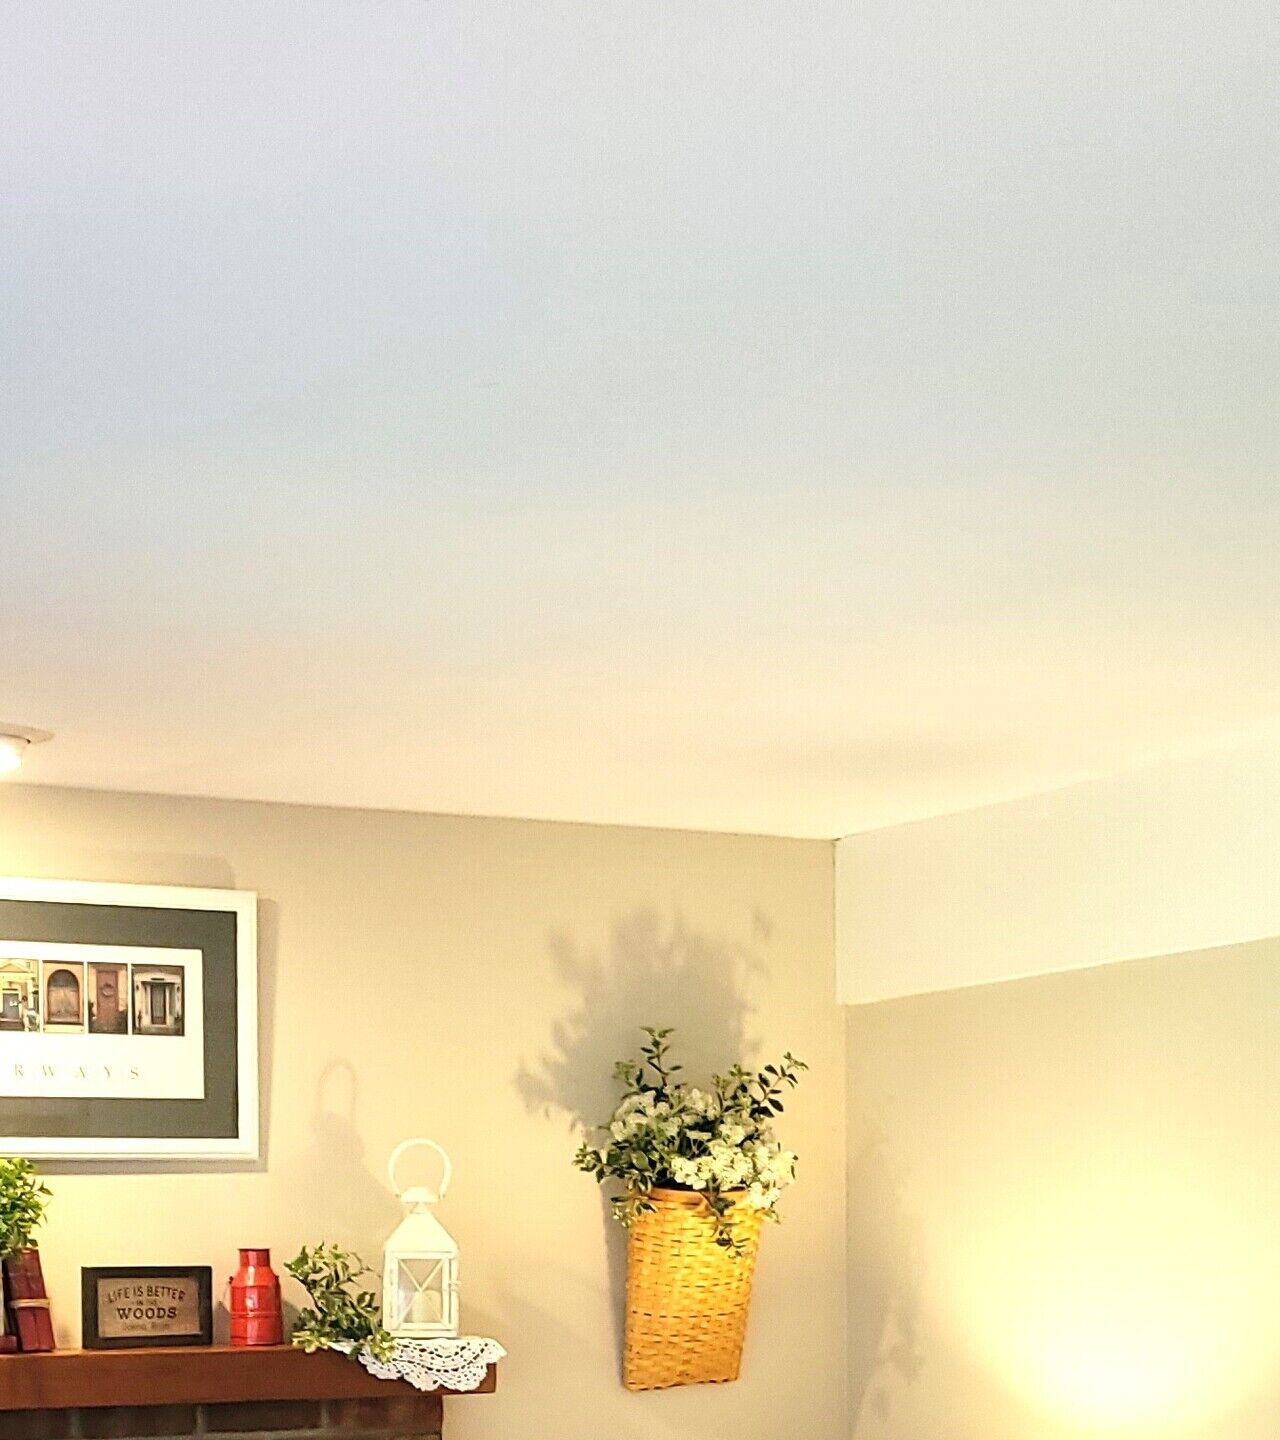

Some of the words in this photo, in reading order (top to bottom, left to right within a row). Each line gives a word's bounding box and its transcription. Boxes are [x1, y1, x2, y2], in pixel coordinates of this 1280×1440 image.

[106, 1286, 130, 1303] LIFE
[133, 1285, 144, 1297] IS
[146, 1285, 186, 1302] BETTER
[116, 1306, 178, 1320] WOODS
